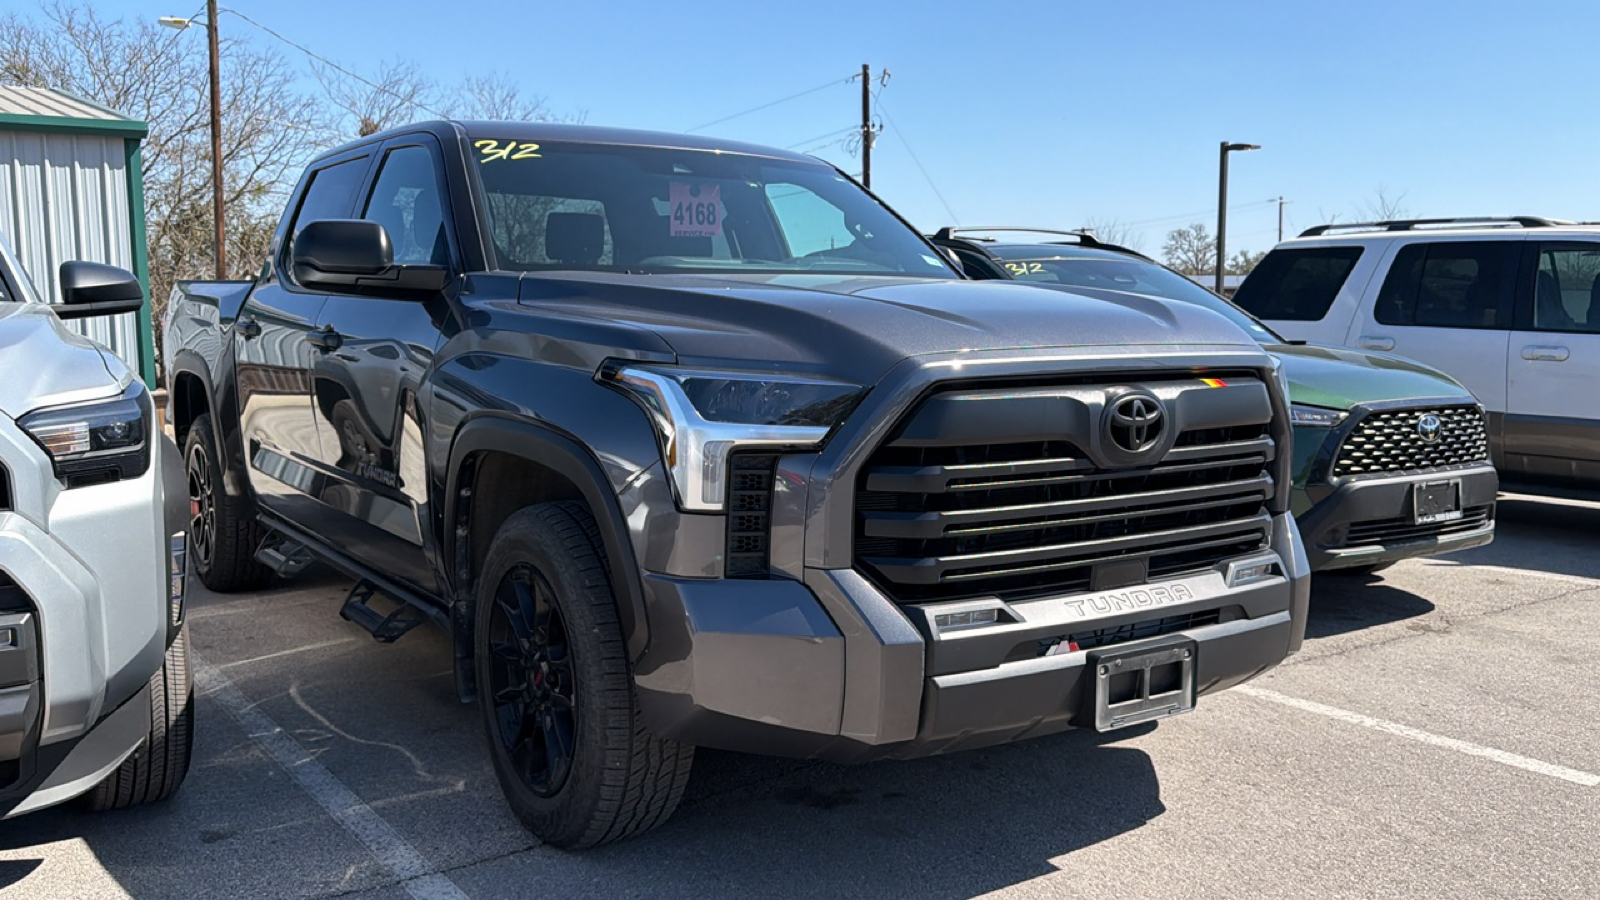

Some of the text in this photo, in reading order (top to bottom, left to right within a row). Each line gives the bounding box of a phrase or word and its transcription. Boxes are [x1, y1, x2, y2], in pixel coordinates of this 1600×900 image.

[474, 140, 542, 164] 312
[674, 201, 716, 226] 4168
[1005, 262, 1046, 275] 312
[356, 461, 397, 490] TUNDRA
[1064, 583, 1194, 617] TUNDRA
